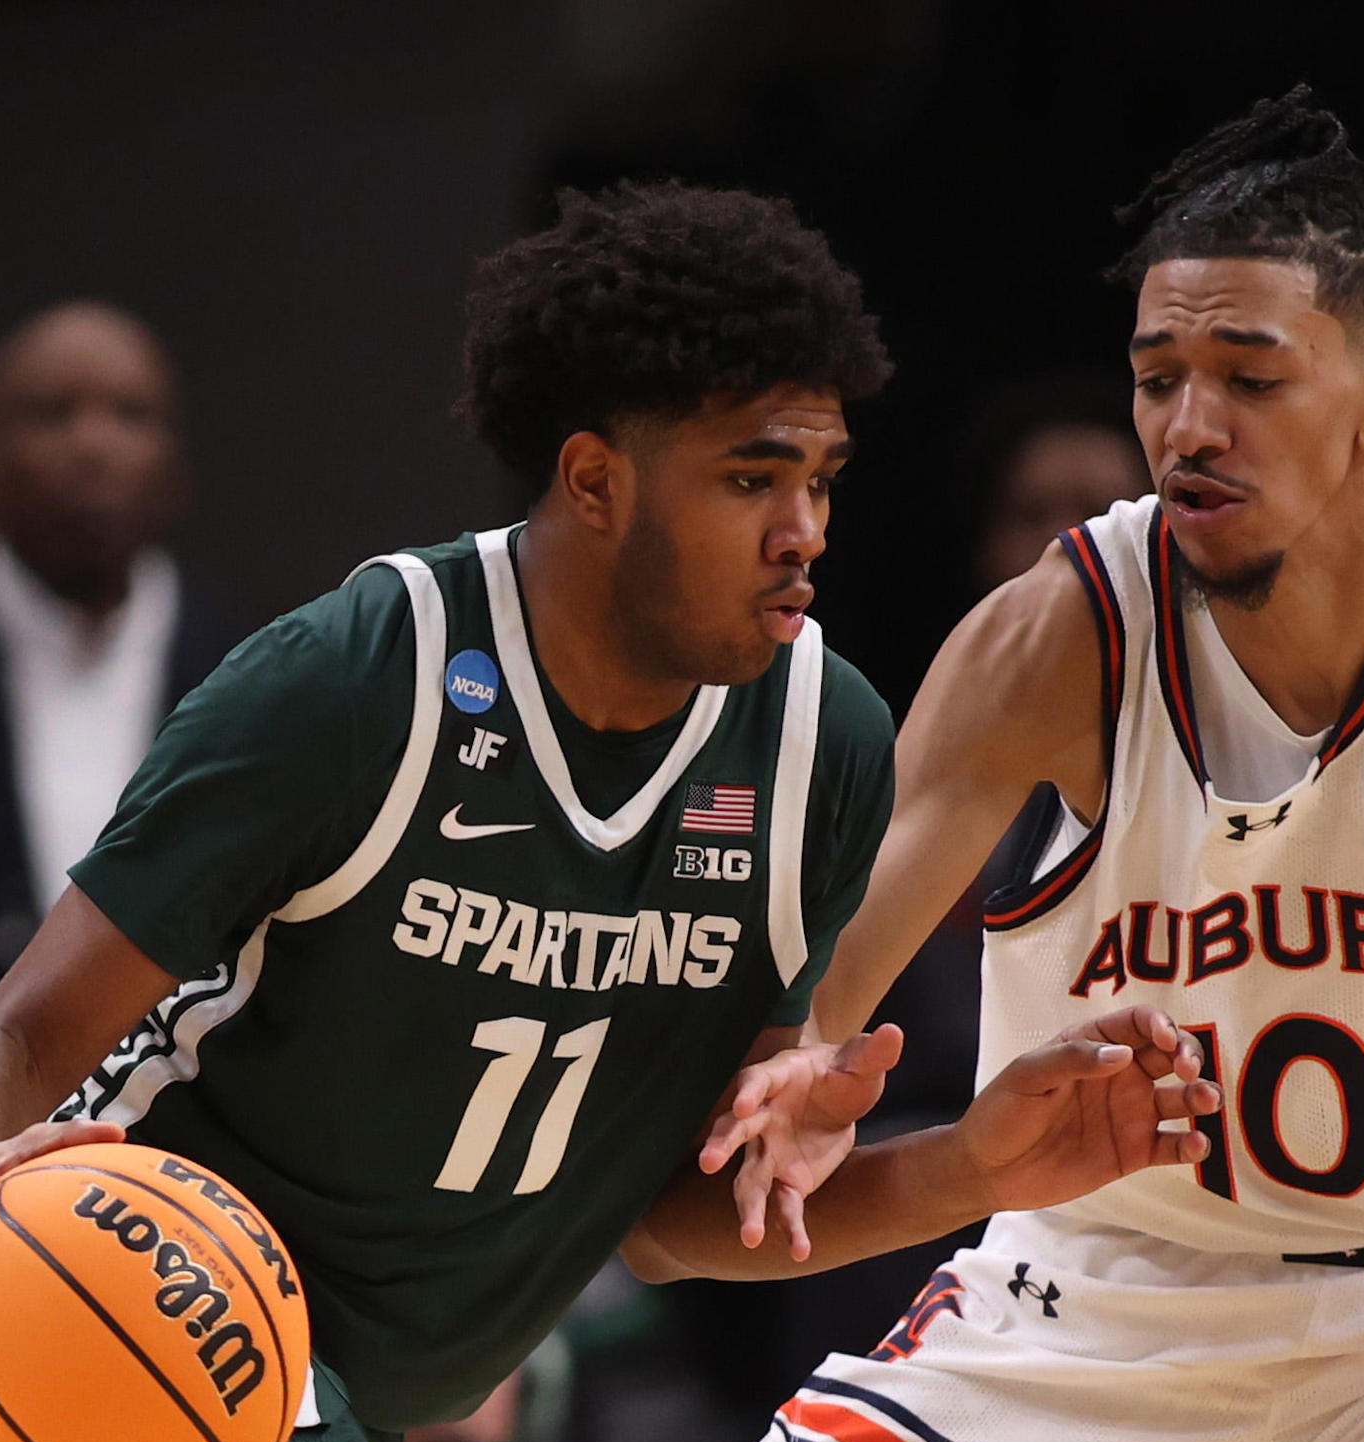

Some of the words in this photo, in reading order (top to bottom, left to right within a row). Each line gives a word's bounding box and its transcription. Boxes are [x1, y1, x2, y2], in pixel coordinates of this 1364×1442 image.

[451, 674, 496, 704] NCAA
[458, 727, 509, 771] JF
[392, 877, 742, 992] SPARTANS
[433, 1016, 612, 1196] 11
[160, 1158, 299, 1299] NCAA
[73, 1182, 266, 1418] Wilson
